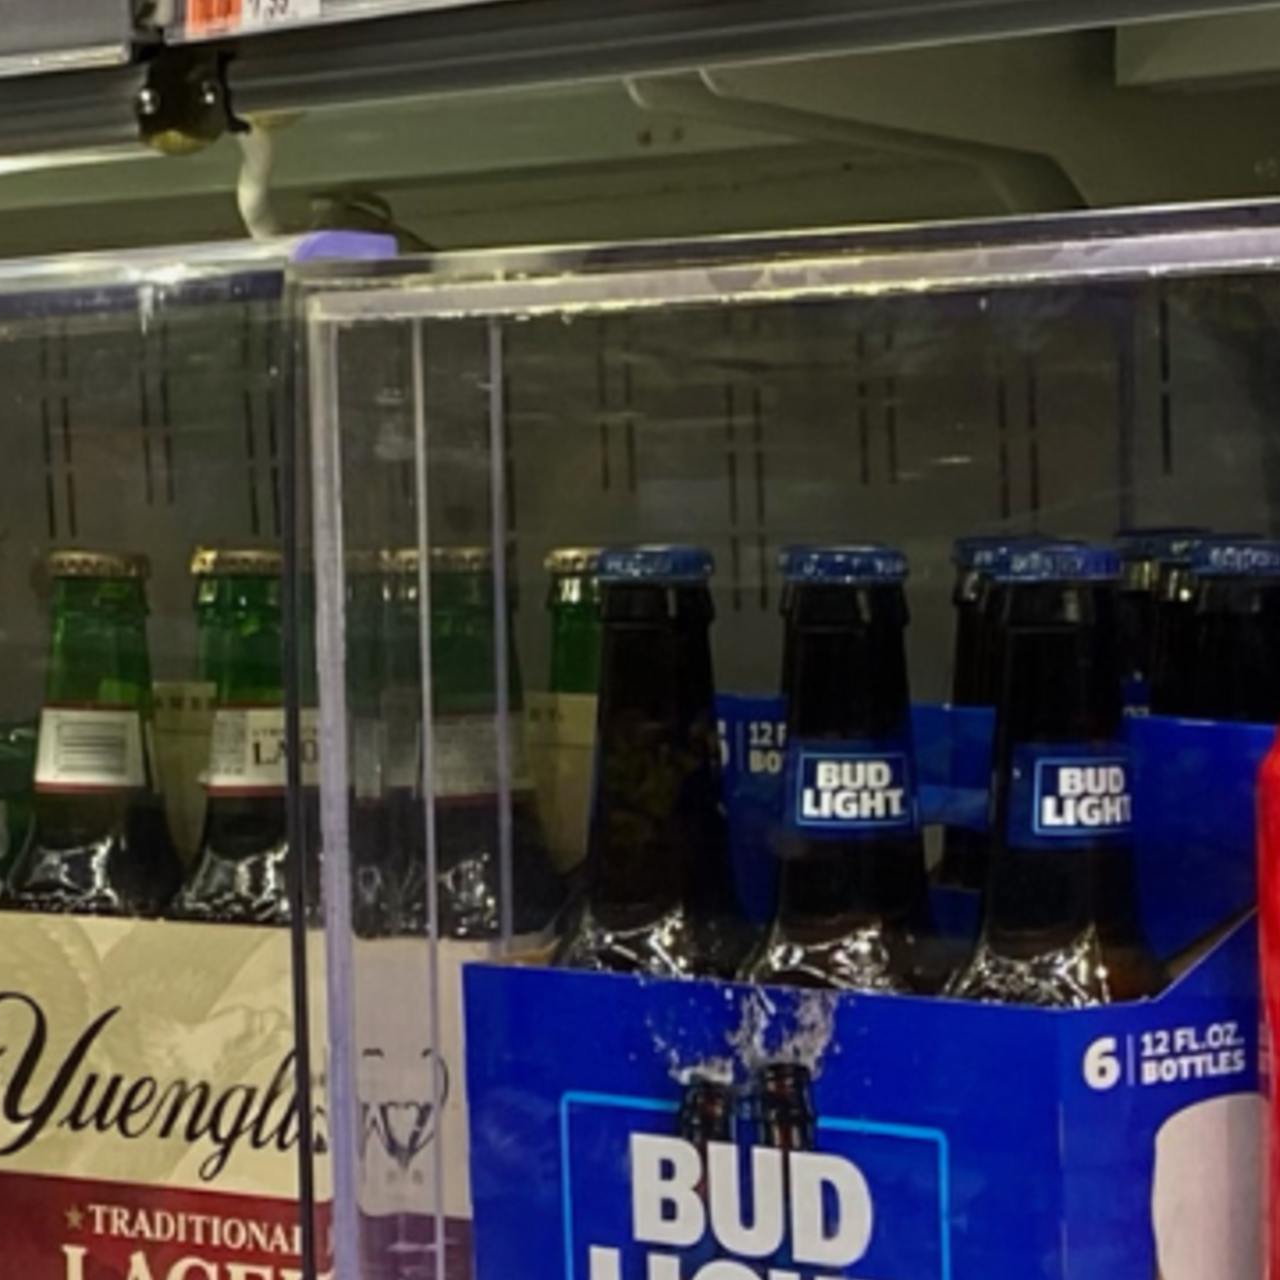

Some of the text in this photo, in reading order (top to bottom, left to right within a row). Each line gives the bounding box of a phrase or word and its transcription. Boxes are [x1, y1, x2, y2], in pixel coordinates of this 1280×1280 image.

[816, 760, 892, 790] BUD
[1058, 766, 1126, 796] BUD
[801, 788, 906, 818] LIGHT
[1140, 1031, 1171, 1058] 12
[1082, 1036, 1120, 1090] 6
[1140, 1051, 1246, 1086] BOTTLES
[628, 1131, 874, 1267] BUD
